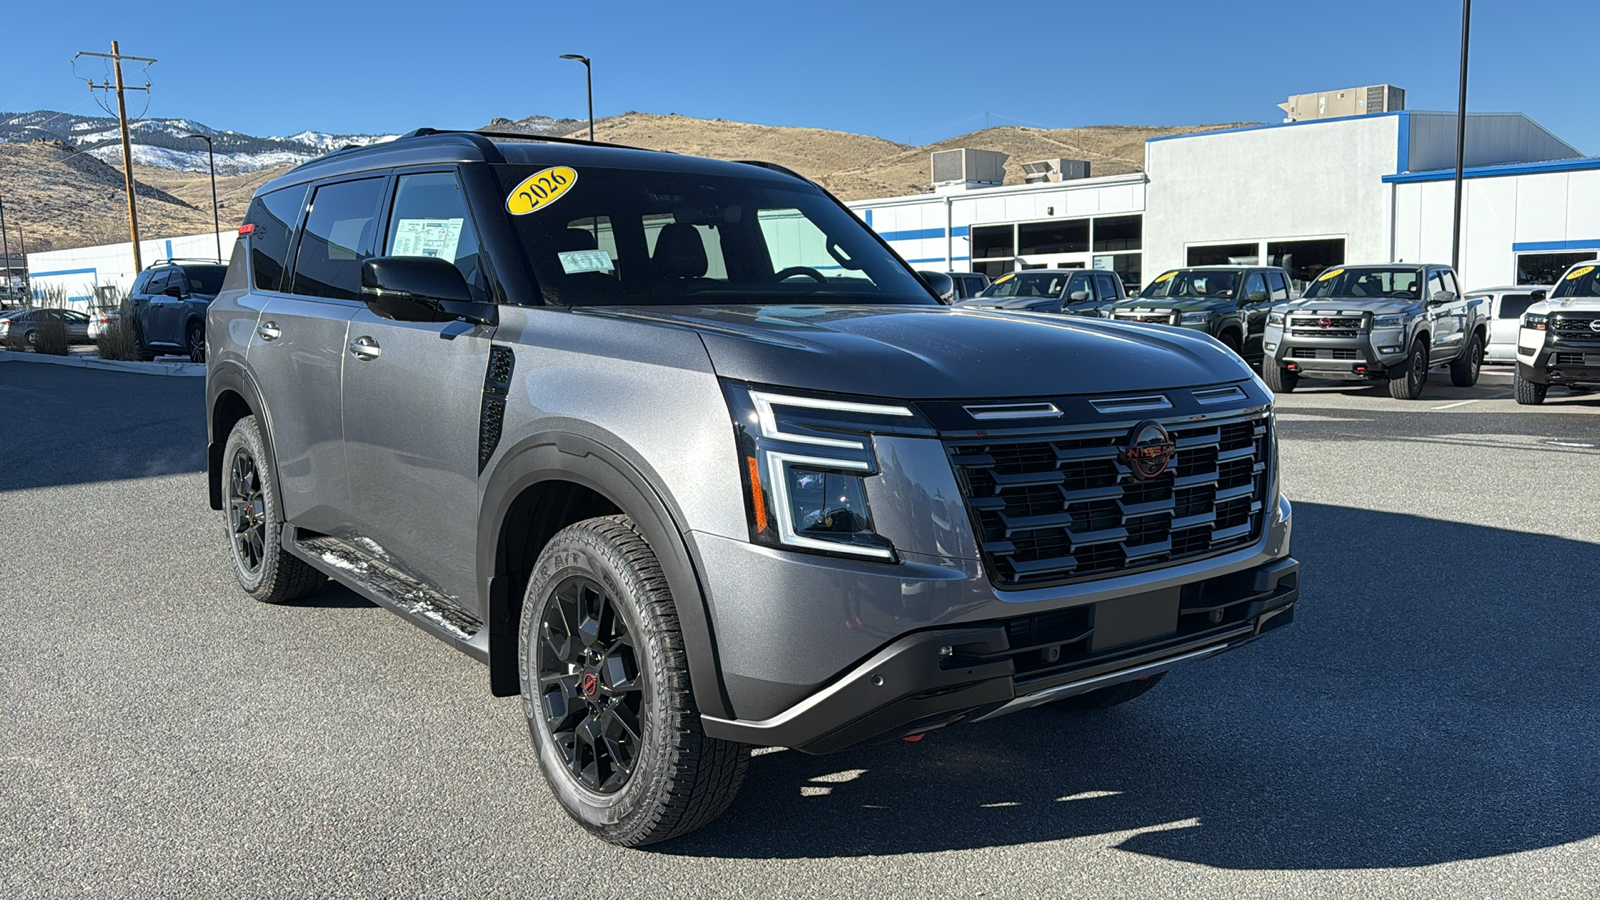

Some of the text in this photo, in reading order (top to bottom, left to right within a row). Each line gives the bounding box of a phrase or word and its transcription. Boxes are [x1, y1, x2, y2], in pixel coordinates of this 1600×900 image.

[519, 170, 567, 208] 2026
[1128, 445, 1175, 458] NISSAN
[555, 552, 580, 570] A/T
